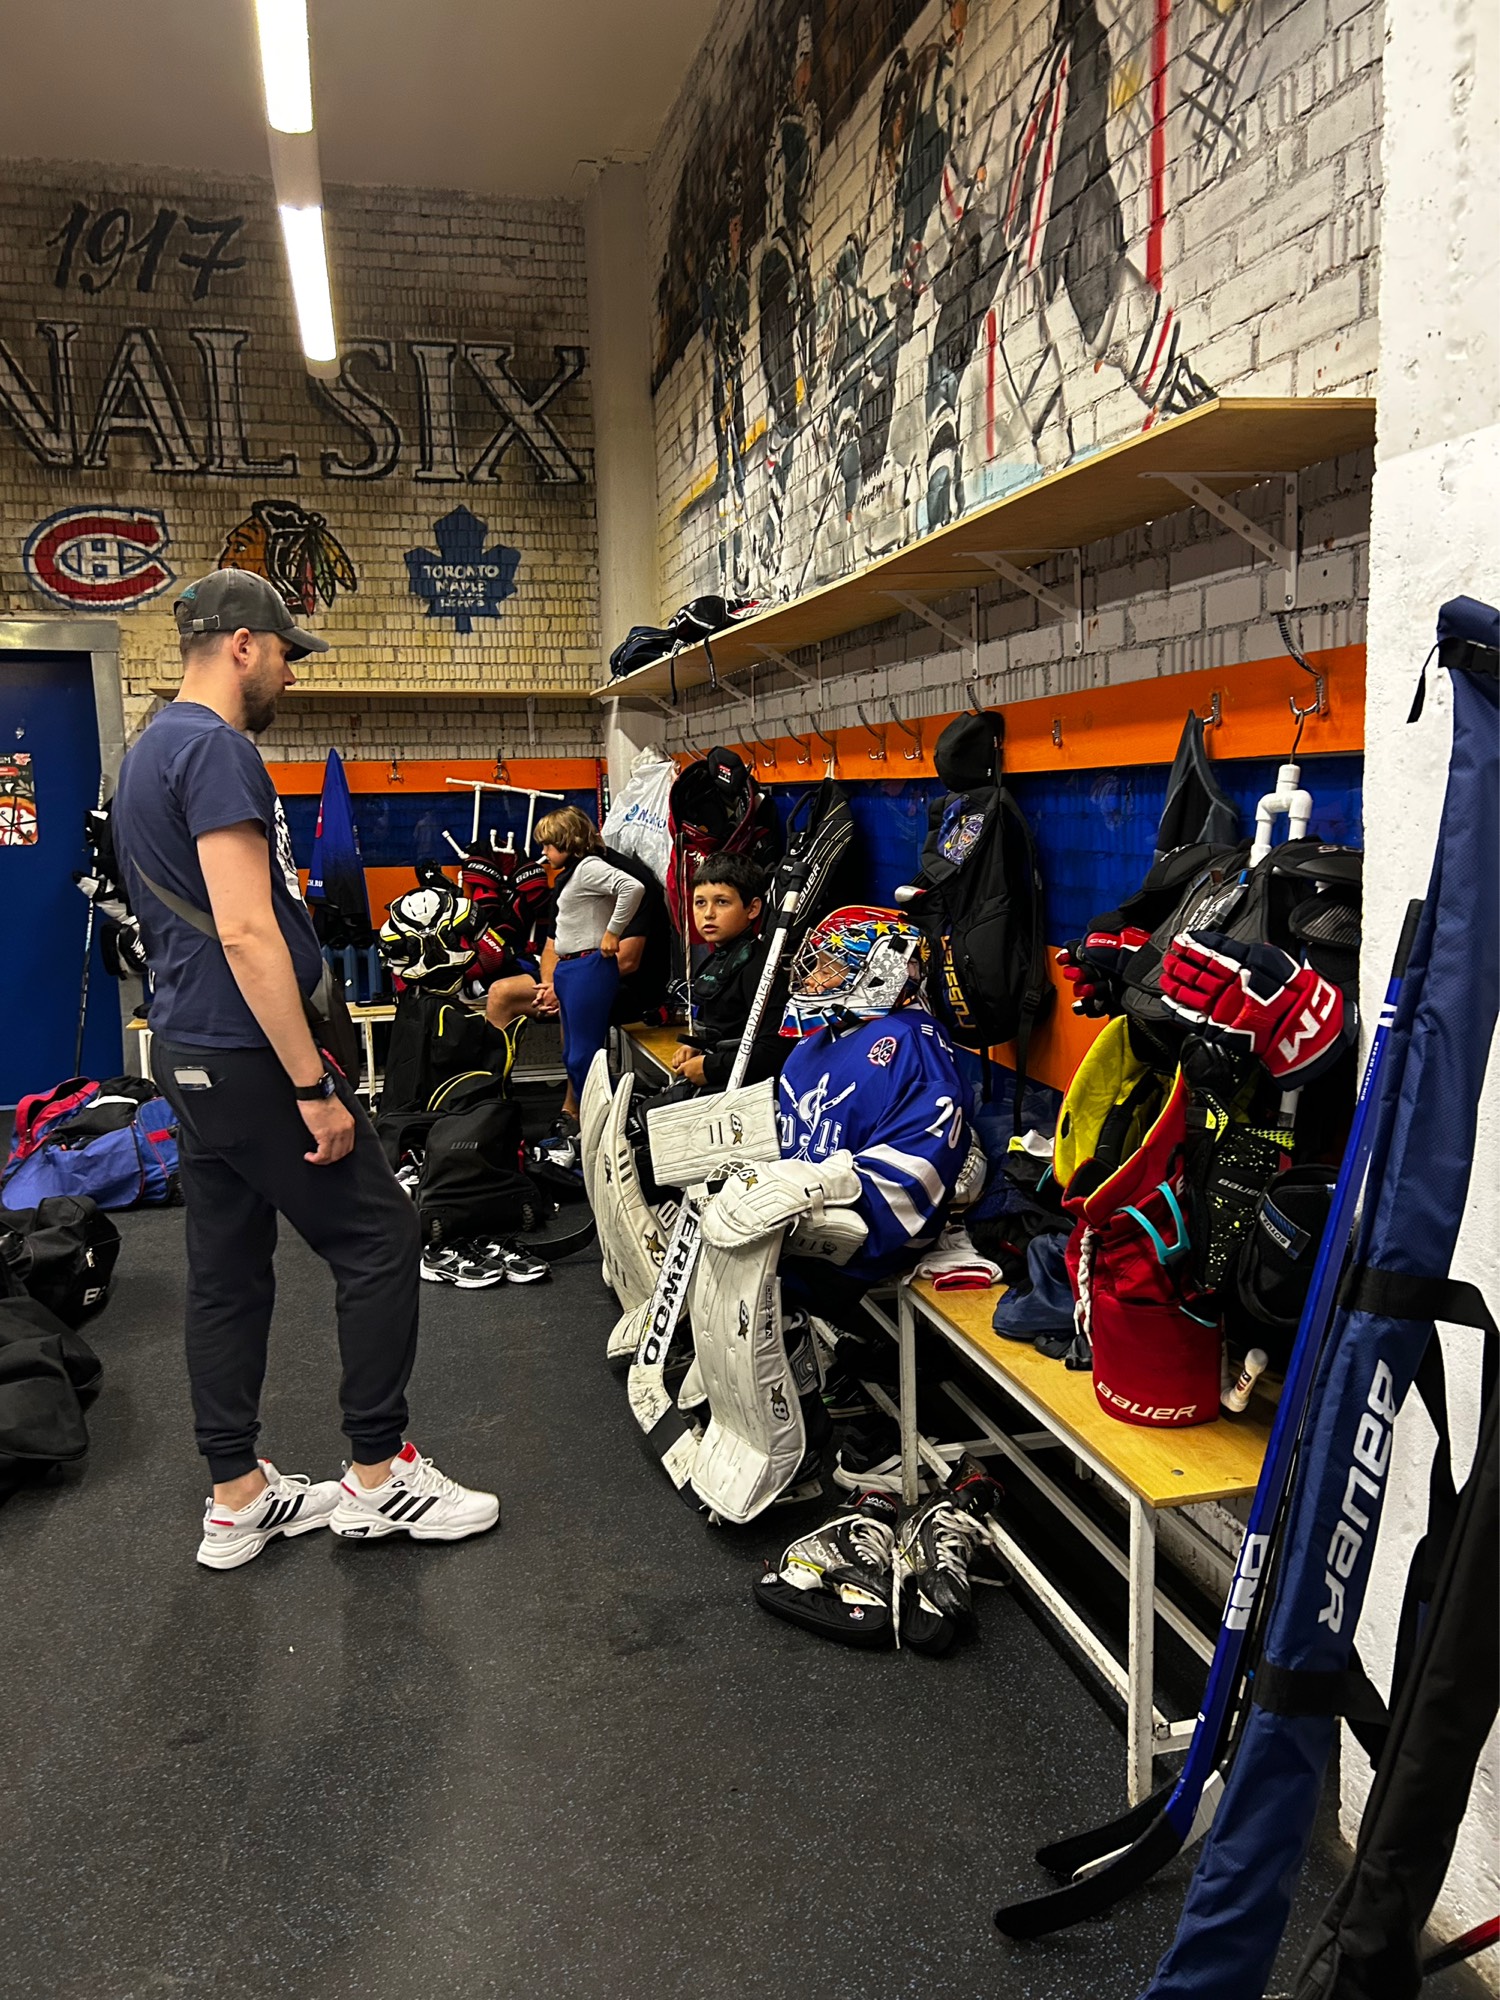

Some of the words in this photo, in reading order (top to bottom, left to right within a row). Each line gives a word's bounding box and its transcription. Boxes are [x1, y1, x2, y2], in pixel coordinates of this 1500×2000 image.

[46, 201, 246, 298] 1917
[315, 337, 589, 483] SIX
[423, 565, 500, 579] TORONTO
[435, 579, 486, 593] MAPLE
[814, 1118, 842, 1156] 15
[925, 1096, 962, 1149] 20
[1097, 1381, 1197, 1420] BAUER
[1318, 1359, 1396, 1633] BAUER
